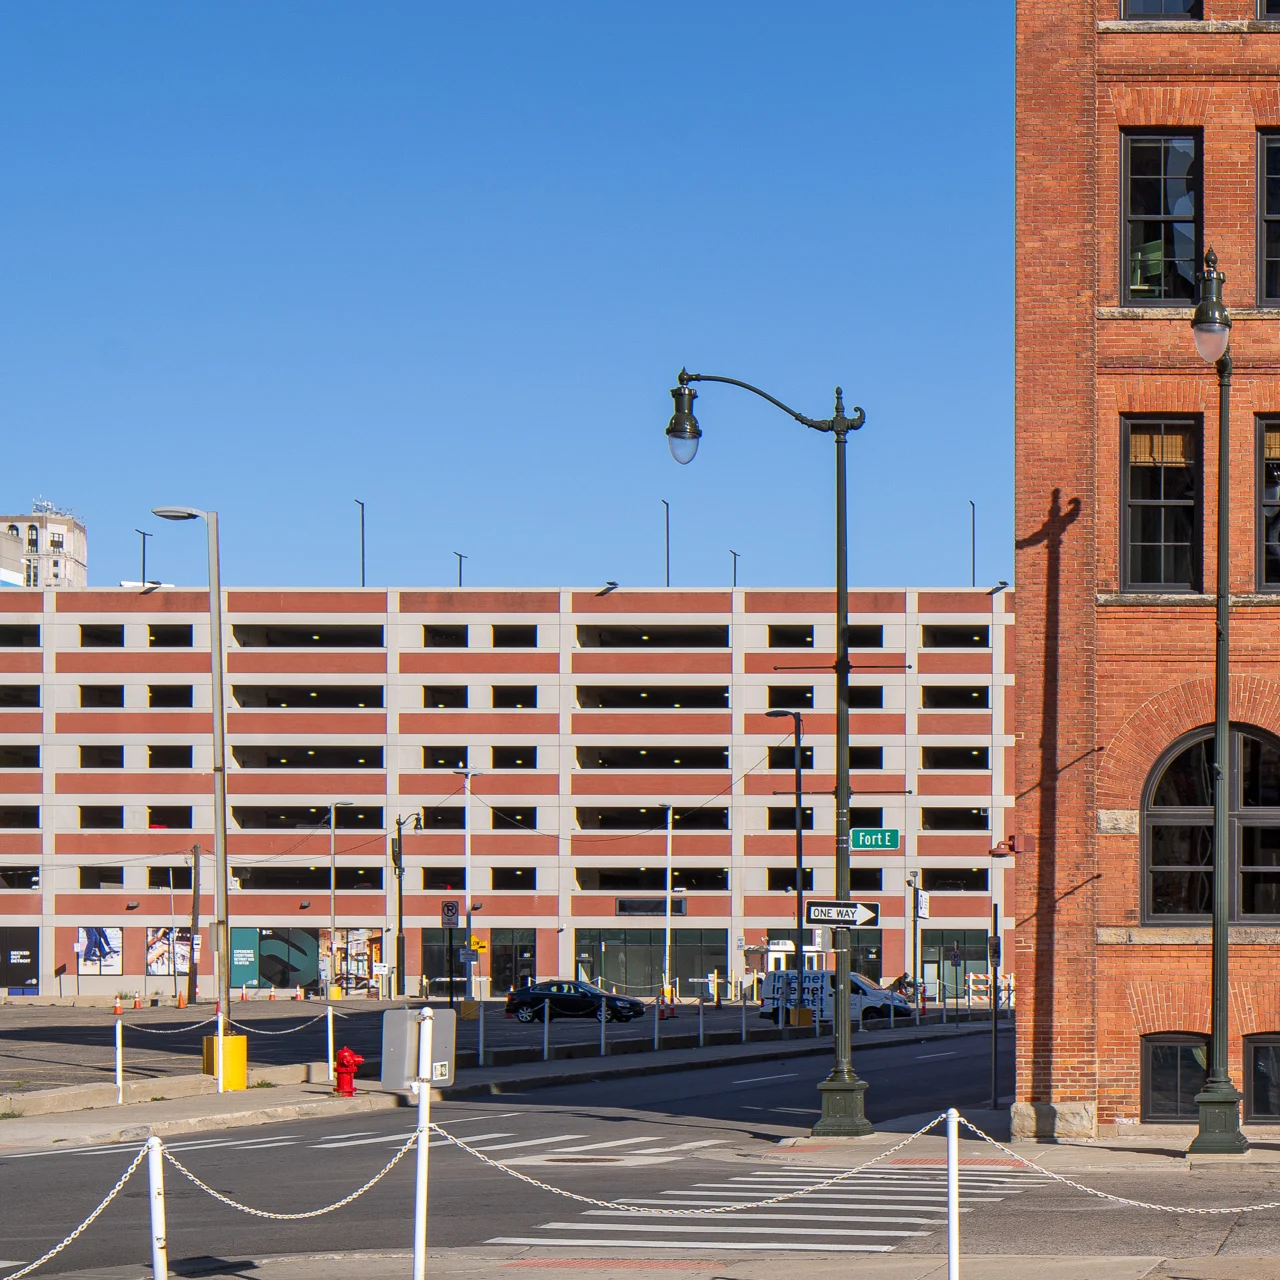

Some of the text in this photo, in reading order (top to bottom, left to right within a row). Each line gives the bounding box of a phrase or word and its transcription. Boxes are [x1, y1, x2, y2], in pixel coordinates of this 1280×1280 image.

[859, 832, 891, 845] Fort E
[813, 908, 857, 918] ONE WAY
[773, 973, 825, 984] Intenet
[772, 984, 824, 995] Inenet
